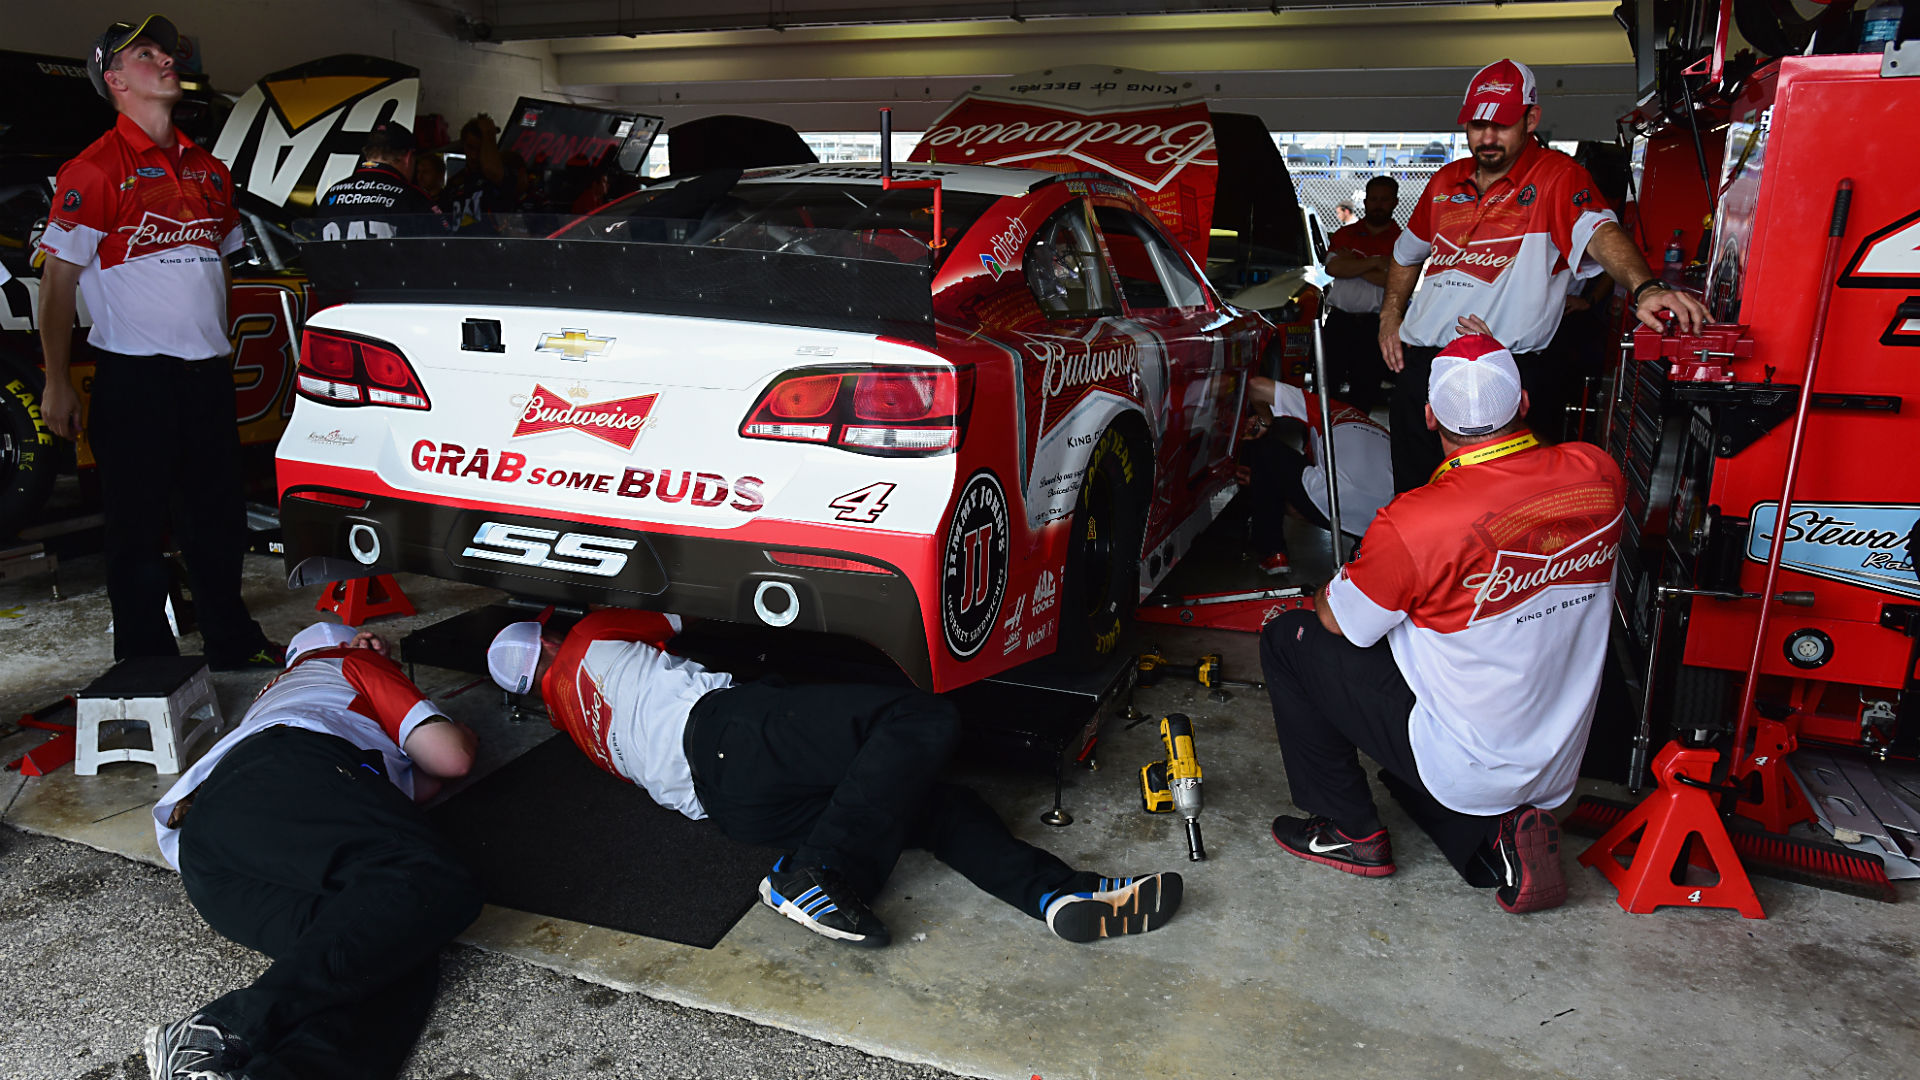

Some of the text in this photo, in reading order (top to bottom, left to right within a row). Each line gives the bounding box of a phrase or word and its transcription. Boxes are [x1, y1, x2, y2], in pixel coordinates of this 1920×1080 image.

[1091, 81, 1116, 92] OF
[1128, 83, 1178, 95] KING
[336, 193, 396, 208] RCRracing
[993, 215, 1029, 266] ditech
[4, 378, 53, 447] EAGLE
[509, 393, 658, 432] Budweiser
[1067, 432, 1092, 448] KING
[410, 438, 766, 513] GRAB SOME BUDS
[828, 482, 898, 524] 4
[461, 521, 639, 578] SS
[947, 488, 978, 578] JIMMY
[960, 522, 994, 615] JJ
[1031, 595, 1055, 617] TOOLS
[1516, 594, 1593, 625] KING OF BEERS
[1756, 757, 1767, 767] 4
[1687, 890, 1702, 903] 4
